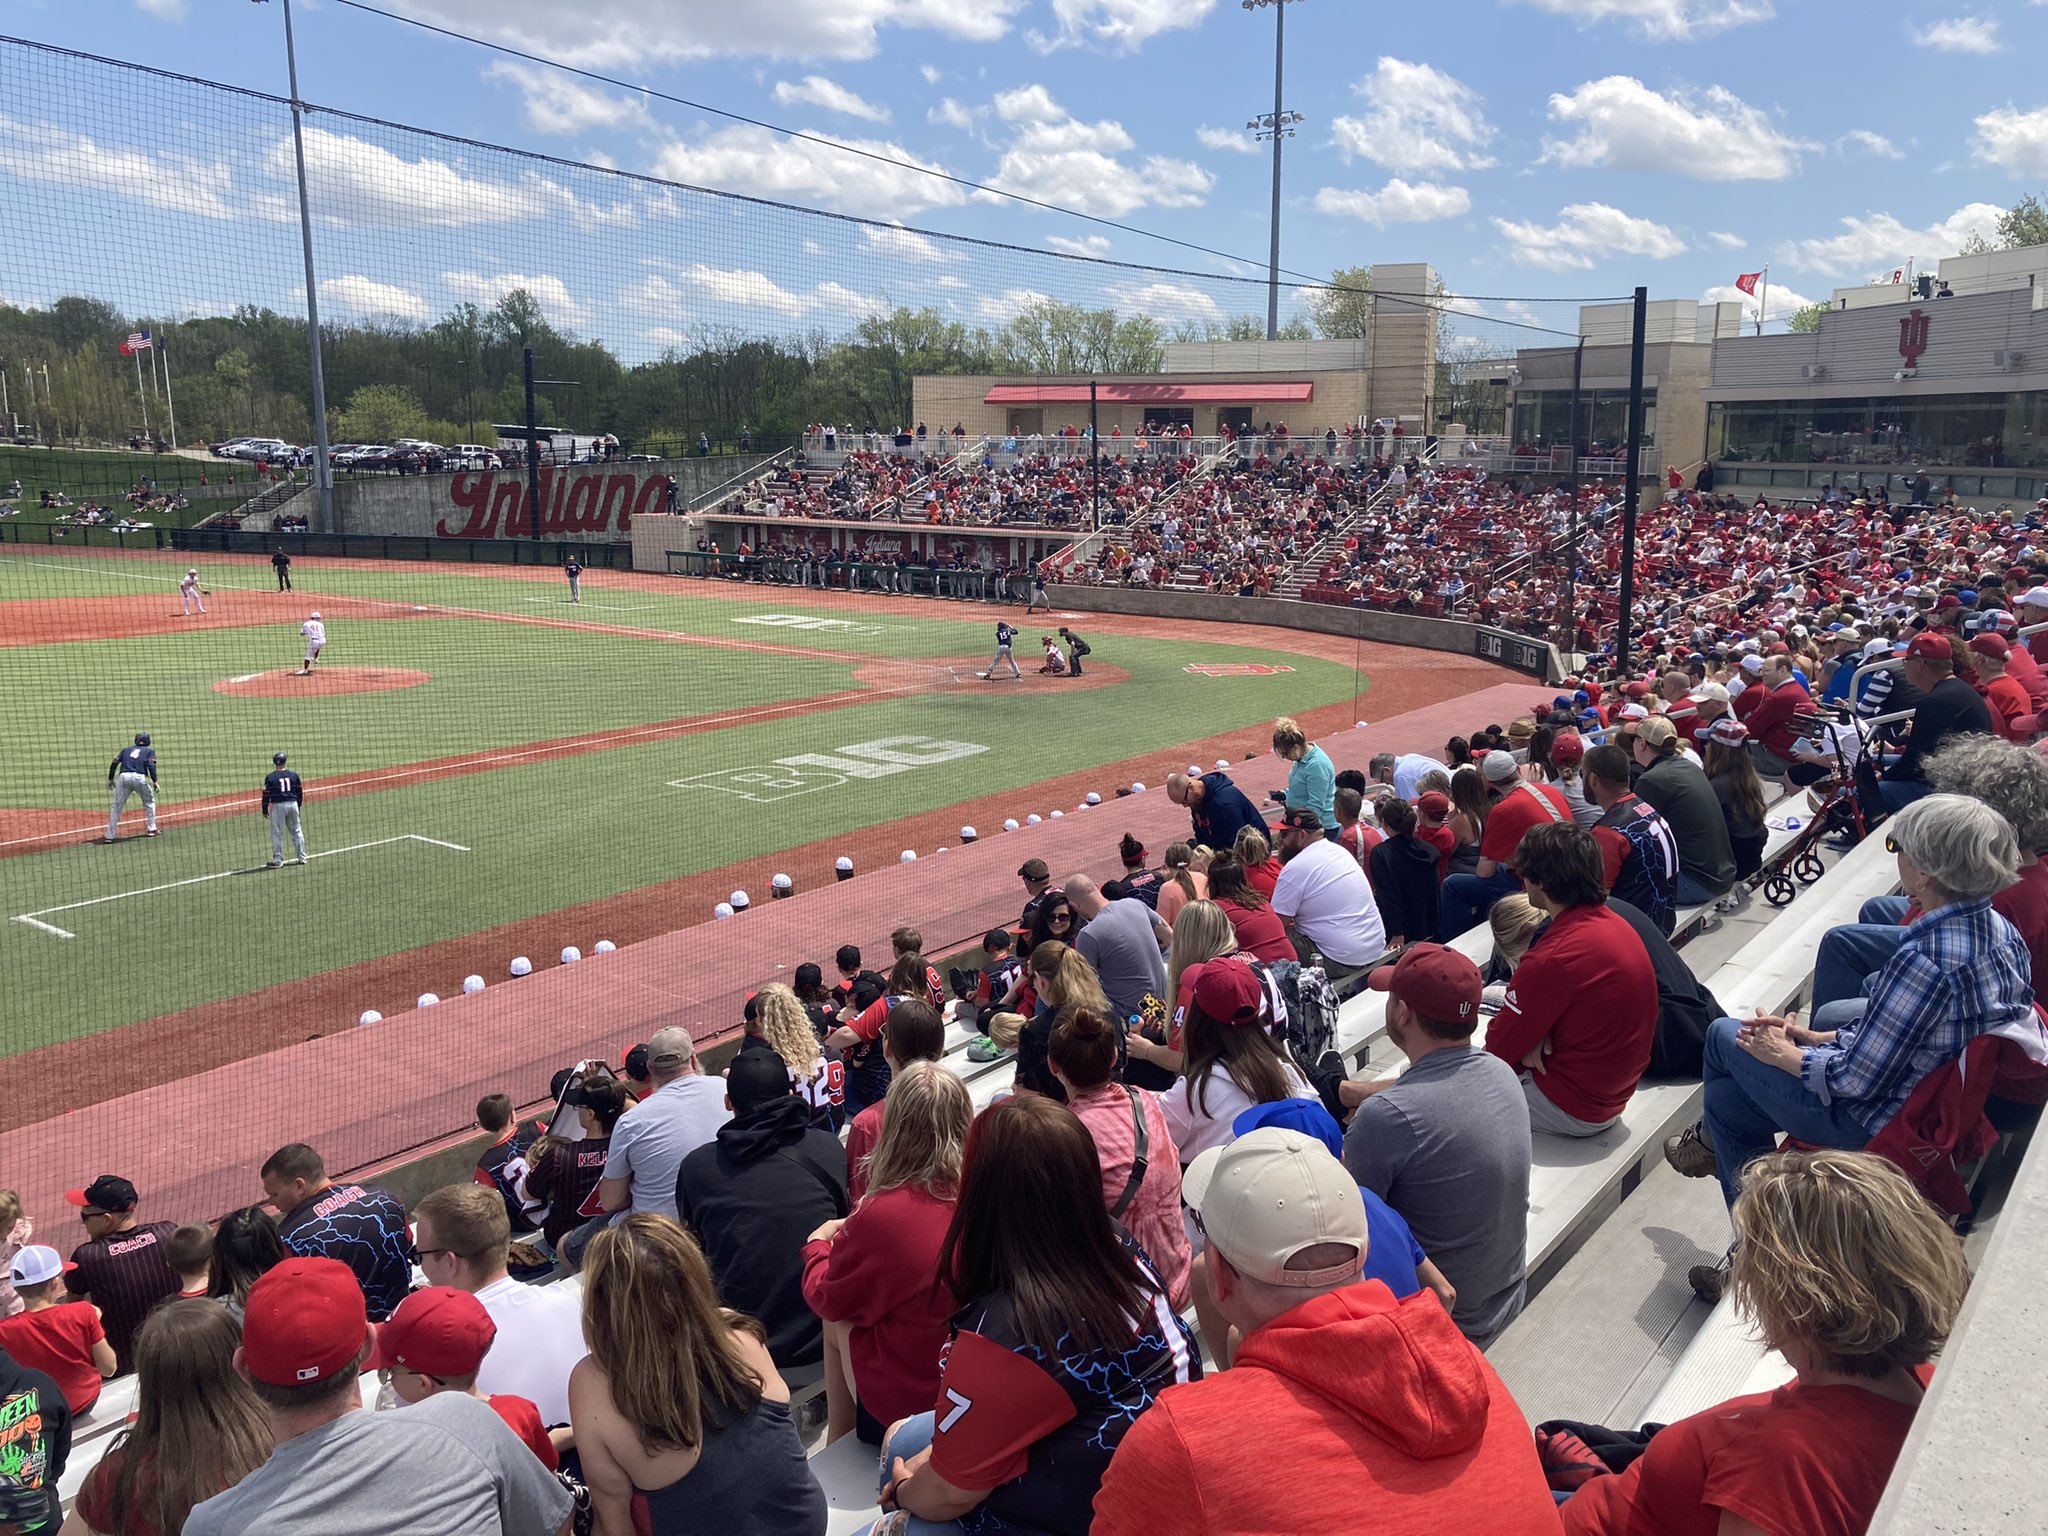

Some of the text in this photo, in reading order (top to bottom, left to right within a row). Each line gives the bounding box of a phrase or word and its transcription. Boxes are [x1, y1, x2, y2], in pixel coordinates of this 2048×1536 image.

[863, 532, 902, 555] Indiana
[999, 631, 1008, 640] 15
[130, 748, 141, 759] 4
[279, 777, 292, 792] 11
[312, 1184, 368, 1218] COACH
[107, 1231, 157, 1256] COACH
[937, 1386, 973, 1435] 7
